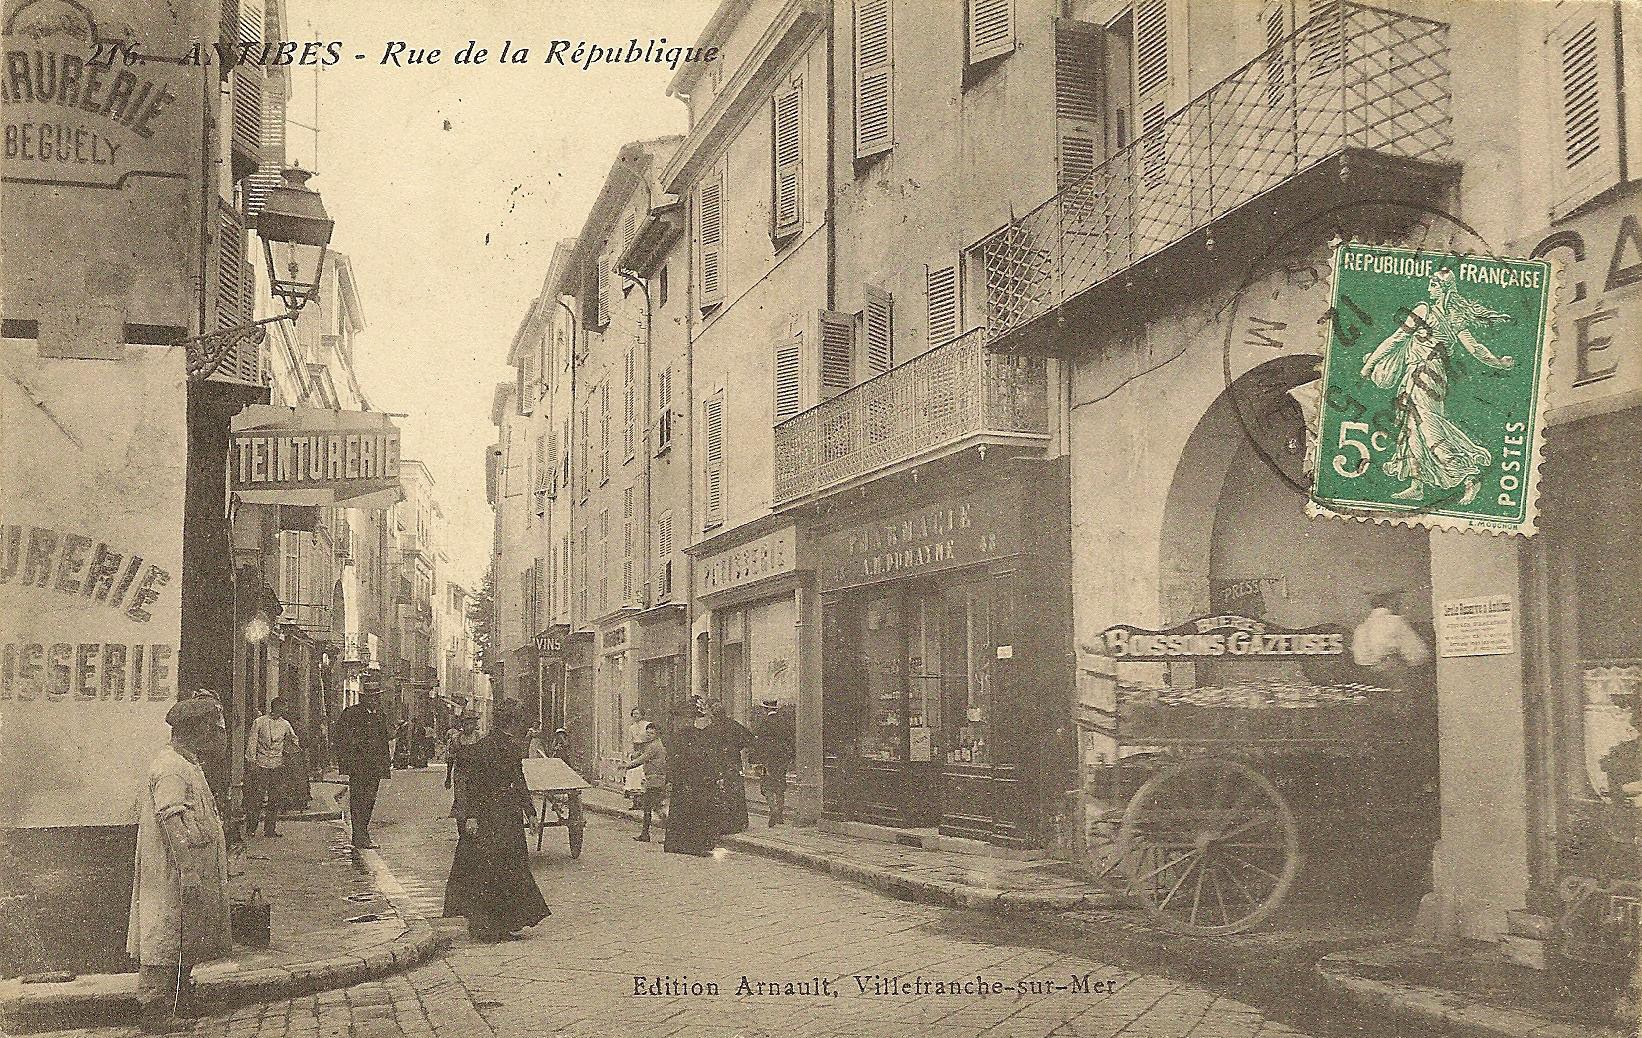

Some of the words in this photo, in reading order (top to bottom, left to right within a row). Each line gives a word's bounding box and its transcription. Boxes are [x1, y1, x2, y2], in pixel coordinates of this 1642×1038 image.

[0, 50, 178, 139] RURERIE
[1342, 251, 1434, 281] REPUBLIQUE
[1459, 262, 1541, 290] FRANÇAISE
[235, 433, 400, 483] TEINTURERIE
[1497, 420, 1527, 507] POSTES
[536, 636, 561, 651] VINS
